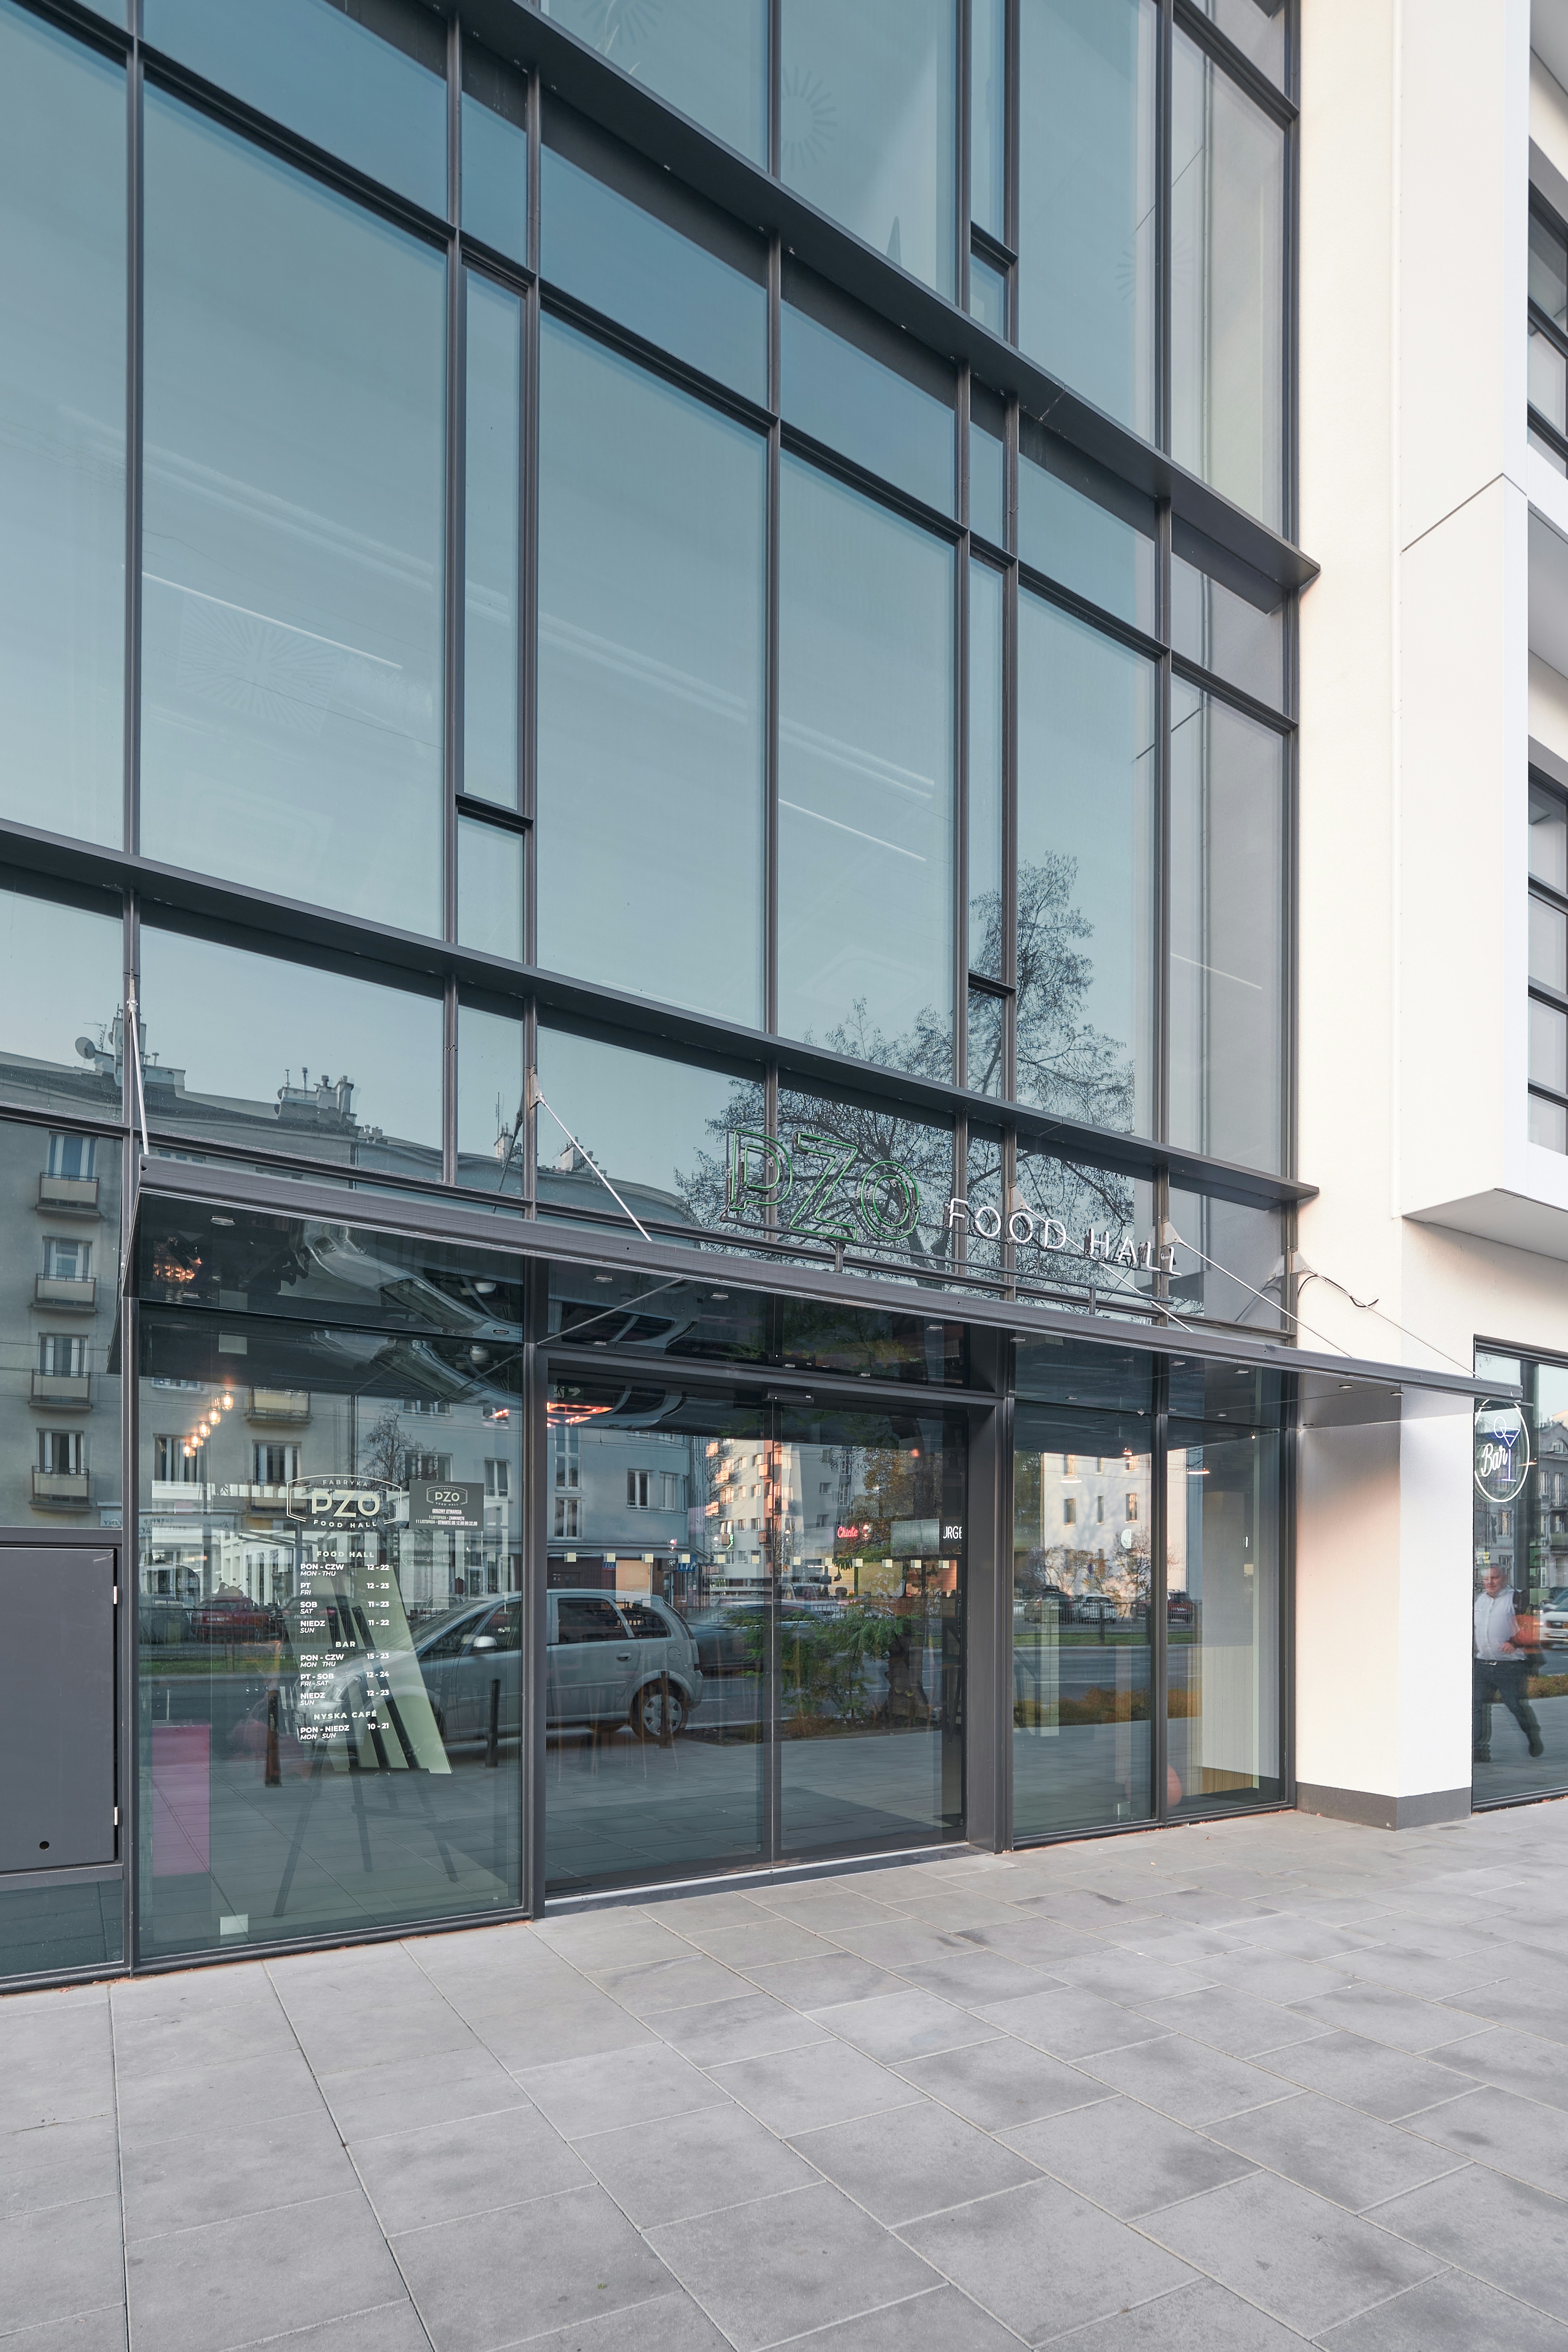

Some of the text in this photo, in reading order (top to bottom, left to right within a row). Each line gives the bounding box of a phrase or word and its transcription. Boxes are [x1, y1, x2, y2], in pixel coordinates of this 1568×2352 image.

[727, 1129, 919, 1242] PZO
[948, 1197, 1182, 1276] FOOD HALL
[1481, 1443, 1508, 1477] Bar
[311, 1490, 380, 1517] PZO
[435, 1491, 459, 1502] PZO
[313, 1520, 343, 1528] FOOD
[351, 1709, 377, 1718] CAFÉ
